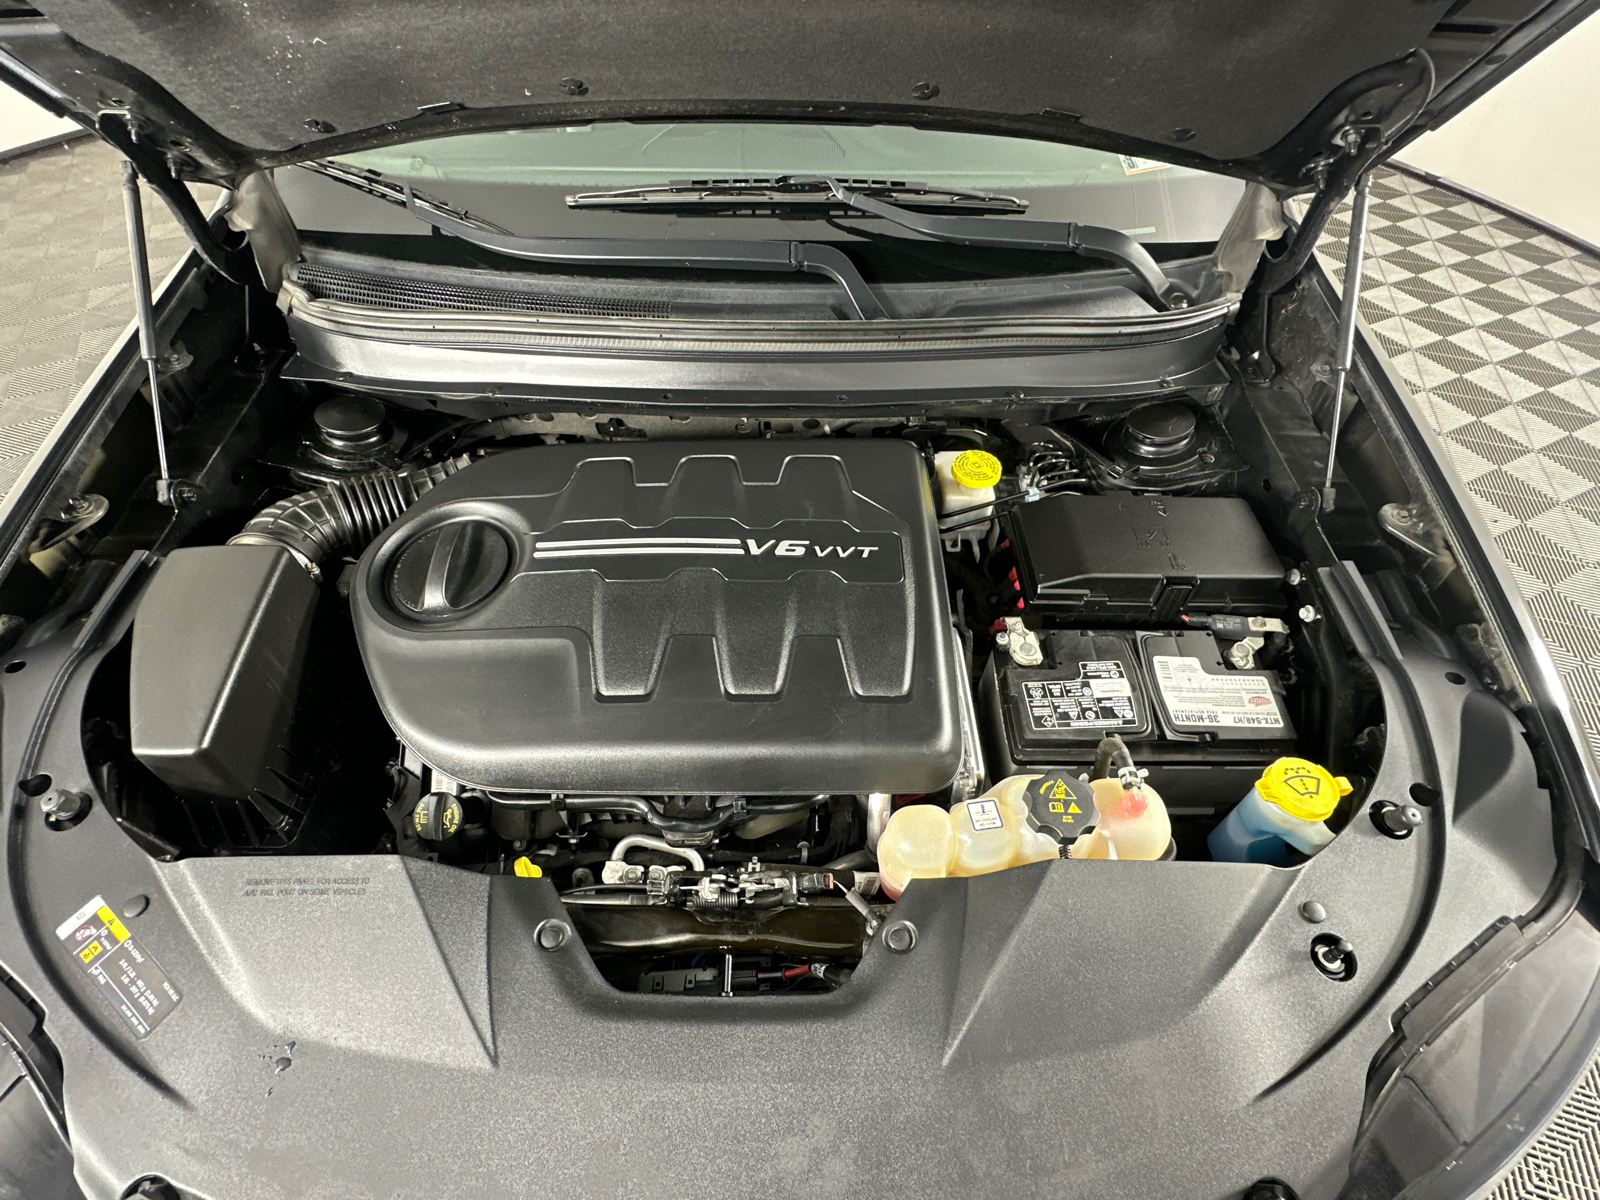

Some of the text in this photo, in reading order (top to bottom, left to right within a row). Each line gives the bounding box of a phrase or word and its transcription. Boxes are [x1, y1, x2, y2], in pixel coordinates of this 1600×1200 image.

[746, 539, 879, 558] V6 VVT
[1173, 713, 1220, 723] 36-MONTH
[1233, 716, 1281, 725] MTX-94R/H7
[448, 803, 459, 833] ENGINE OIL
[246, 878, 274, 886] REMOVE
[276, 878, 292, 886] THIS
[293, 878, 315, 886] PANEL
[332, 877, 359, 885] ACCESS
[360, 877, 370, 885] TO
[243, 888, 258, 897] A/C
[277, 888, 296, 896] PORT
[297, 888, 307, 896] ON
[309, 888, 331, 896] SOME
[332, 888, 367, 896] VEHICLES
